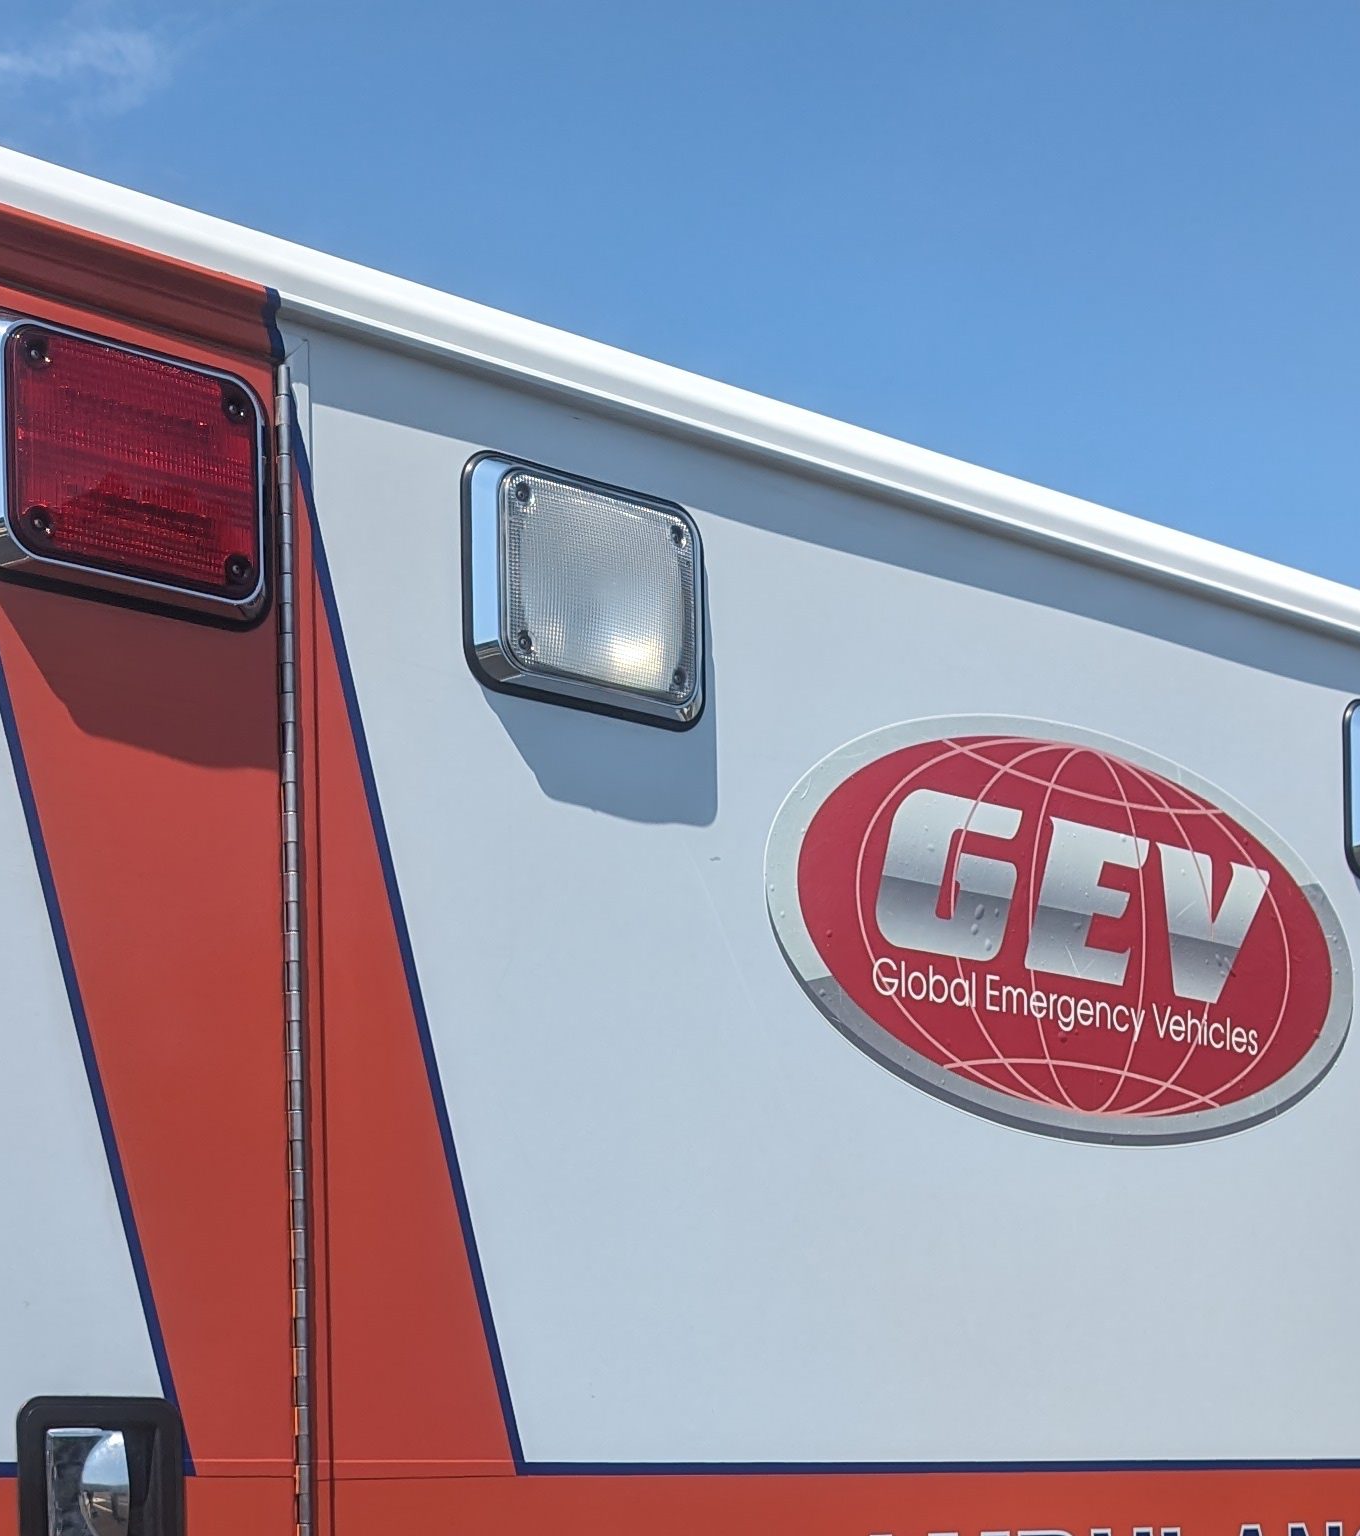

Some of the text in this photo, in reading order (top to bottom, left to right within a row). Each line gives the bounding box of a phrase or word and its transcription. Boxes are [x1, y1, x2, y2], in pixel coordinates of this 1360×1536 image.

[875, 789, 1270, 1004] GEV
[872, 957, 1259, 1056] Global Emergency Vehicles
